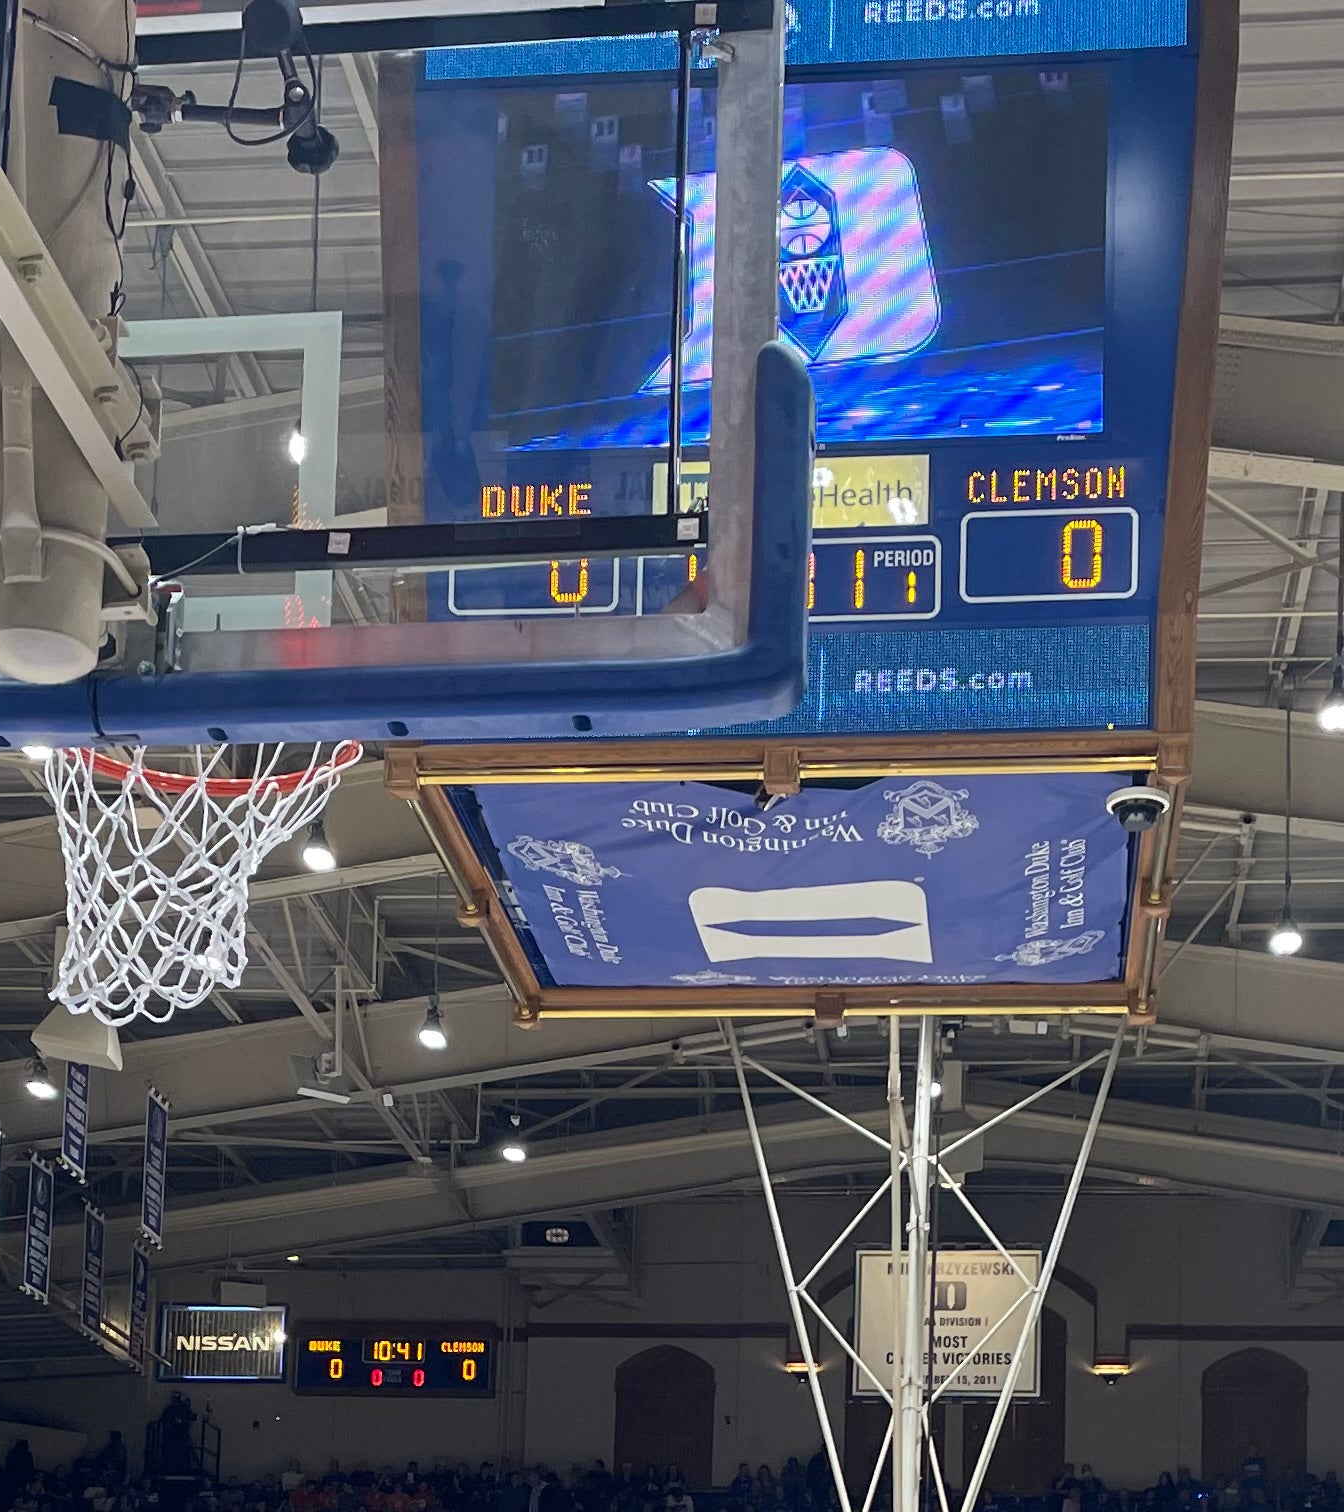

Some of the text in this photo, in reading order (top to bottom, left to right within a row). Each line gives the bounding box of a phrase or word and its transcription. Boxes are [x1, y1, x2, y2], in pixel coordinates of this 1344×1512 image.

[864, 0, 1040, 24] REEDS.com
[966, 466, 1126, 503] CLEMSON
[482, 483, 592, 517] DUKE
[873, 549, 934, 568] PERIOD
[1062, 519, 1102, 588] 0
[854, 667, 1033, 692] REEDS.com
[632, 799, 700, 819] Club
[706, 806, 766, 836] Golf
[621, 817, 864, 855] Waington Duke
[1025, 841, 1055, 938] Washington Duke
[938, 1316, 982, 1328] DIVISION
[176, 1335, 273, 1351] NISSAN
[308, 1340, 486, 1361] DUKE 10:41 CLEMSON
[329, 1358, 476, 1381] 0 0
[975, 1374, 998, 1386] 2011
